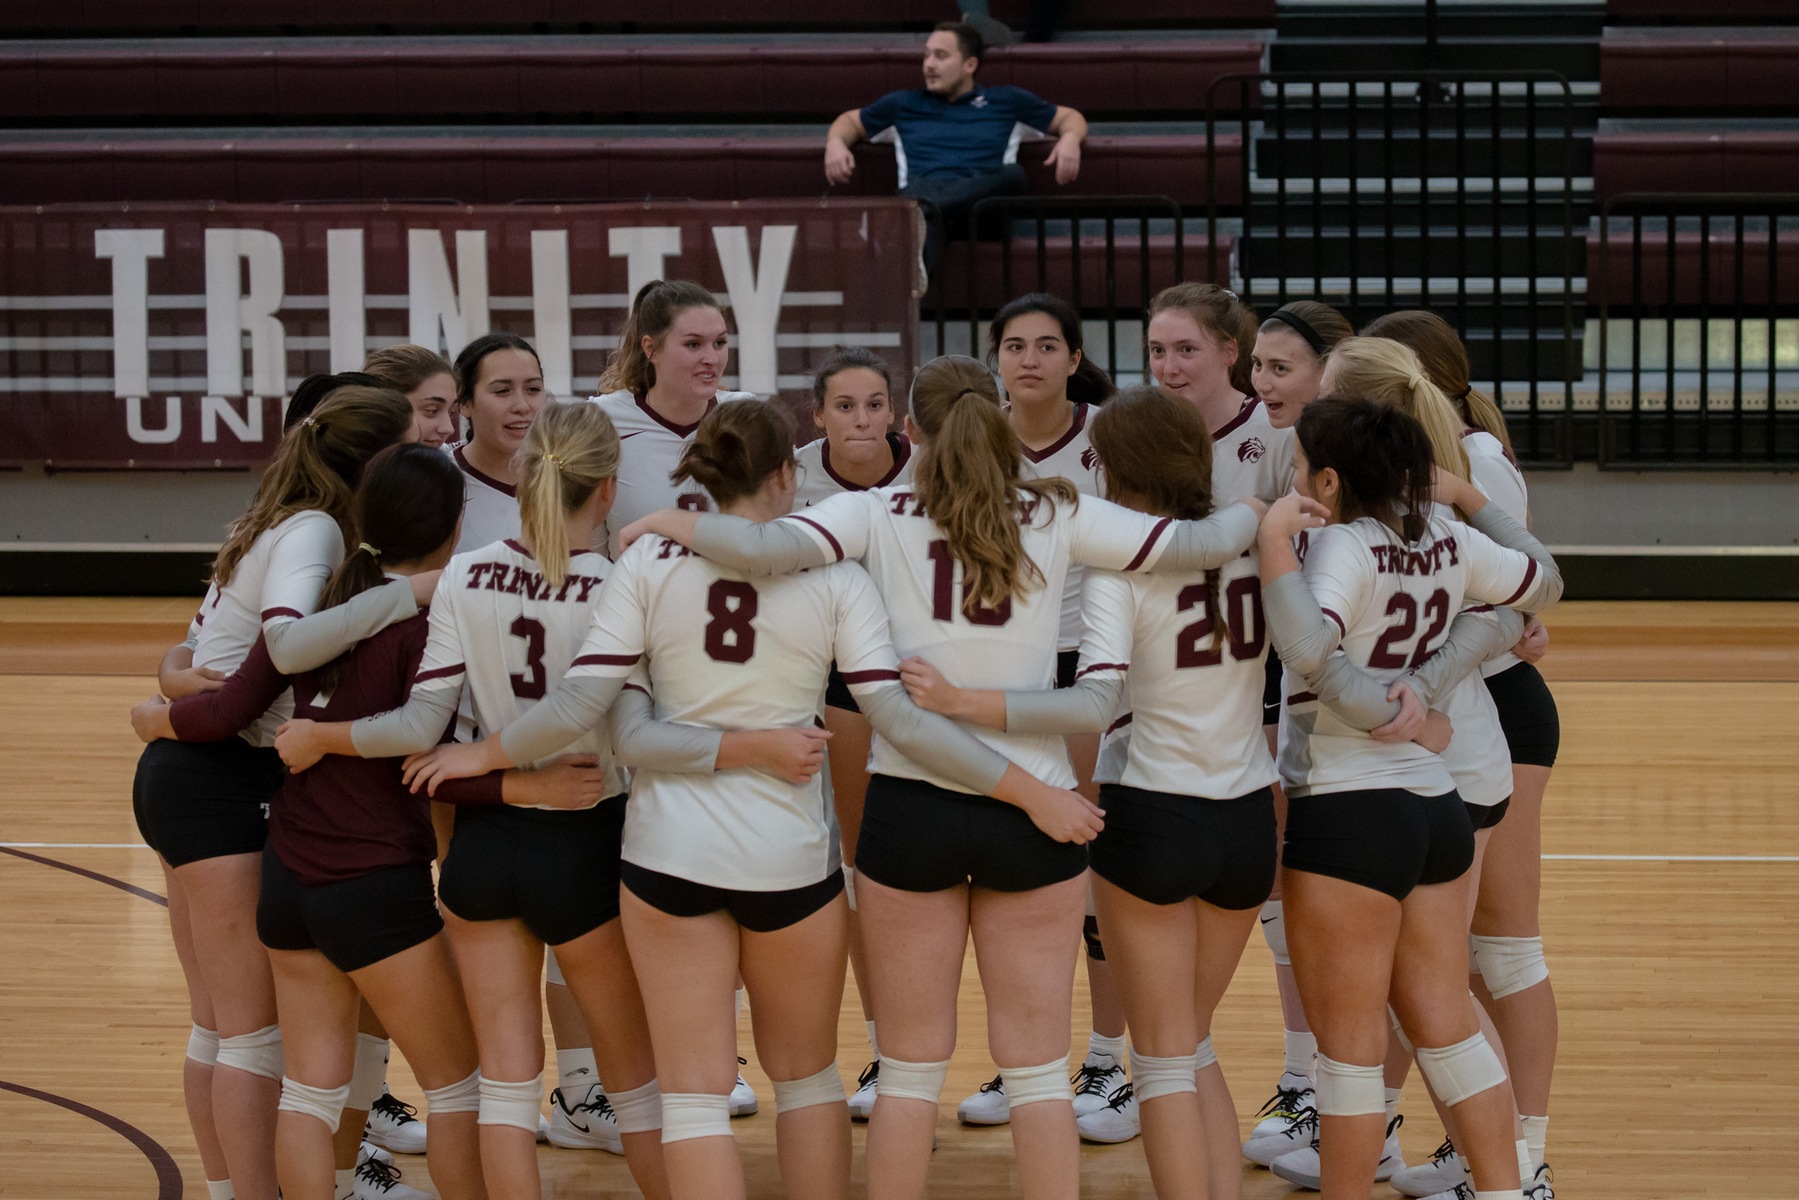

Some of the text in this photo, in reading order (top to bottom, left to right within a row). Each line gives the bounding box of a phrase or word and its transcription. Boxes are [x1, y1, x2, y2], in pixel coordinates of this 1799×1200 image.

[466, 561, 604, 603] TRINITY
[1369, 536, 1459, 577] TRINTY
[509, 613, 548, 701] 3
[704, 578, 758, 665] 8
[1175, 574, 1266, 670] 20
[1366, 587, 1451, 669] 22
